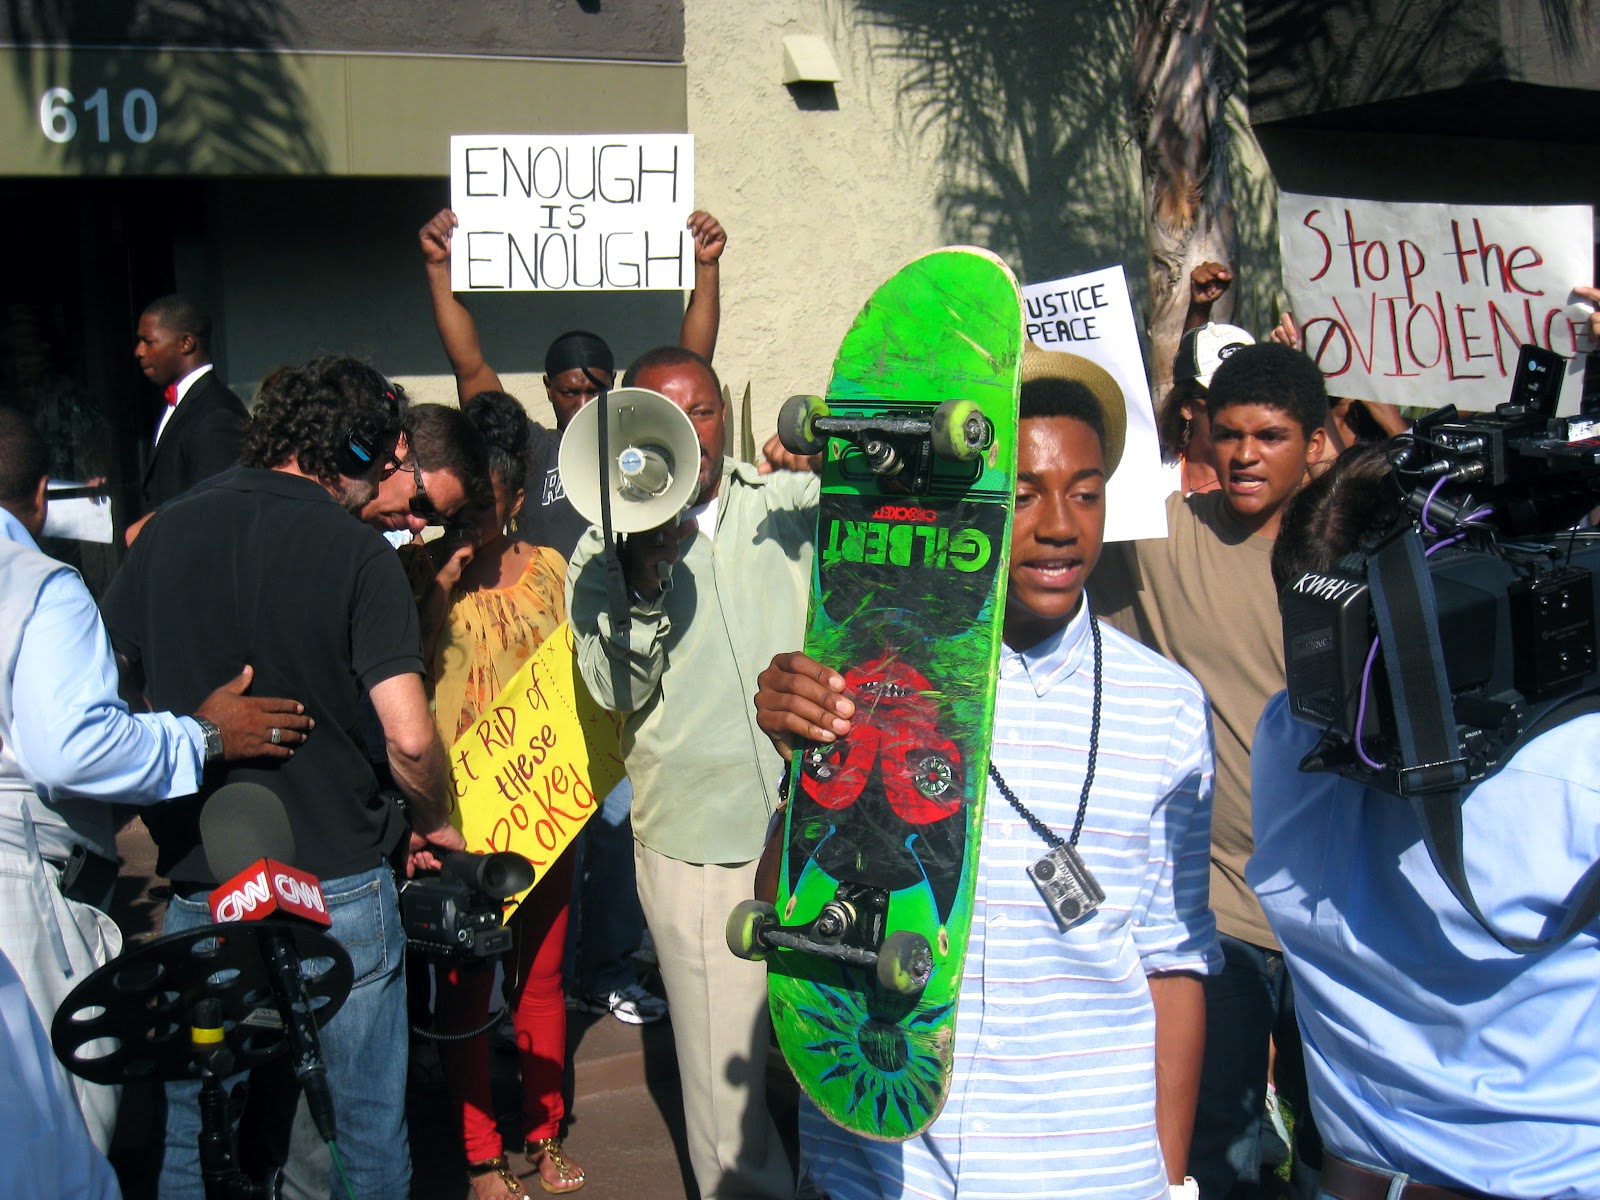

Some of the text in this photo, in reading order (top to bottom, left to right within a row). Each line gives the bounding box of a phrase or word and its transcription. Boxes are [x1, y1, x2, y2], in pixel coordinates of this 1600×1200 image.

[40, 87, 158, 143] 610
[466, 145, 678, 203] ENOUGH
[540, 204, 586, 229] IS
[467, 231, 683, 289] ENOUGH
[1304, 209, 1544, 309] Stop the
[1024, 283, 1109, 319] USTICE
[1026, 316, 1101, 343] PEACE
[822, 520, 992, 573] GILBERT
[1293, 572, 1359, 600] KWHY
[526, 662, 549, 710] of
[216, 871, 271, 923] CNN
[274, 873, 326, 913] CNN
